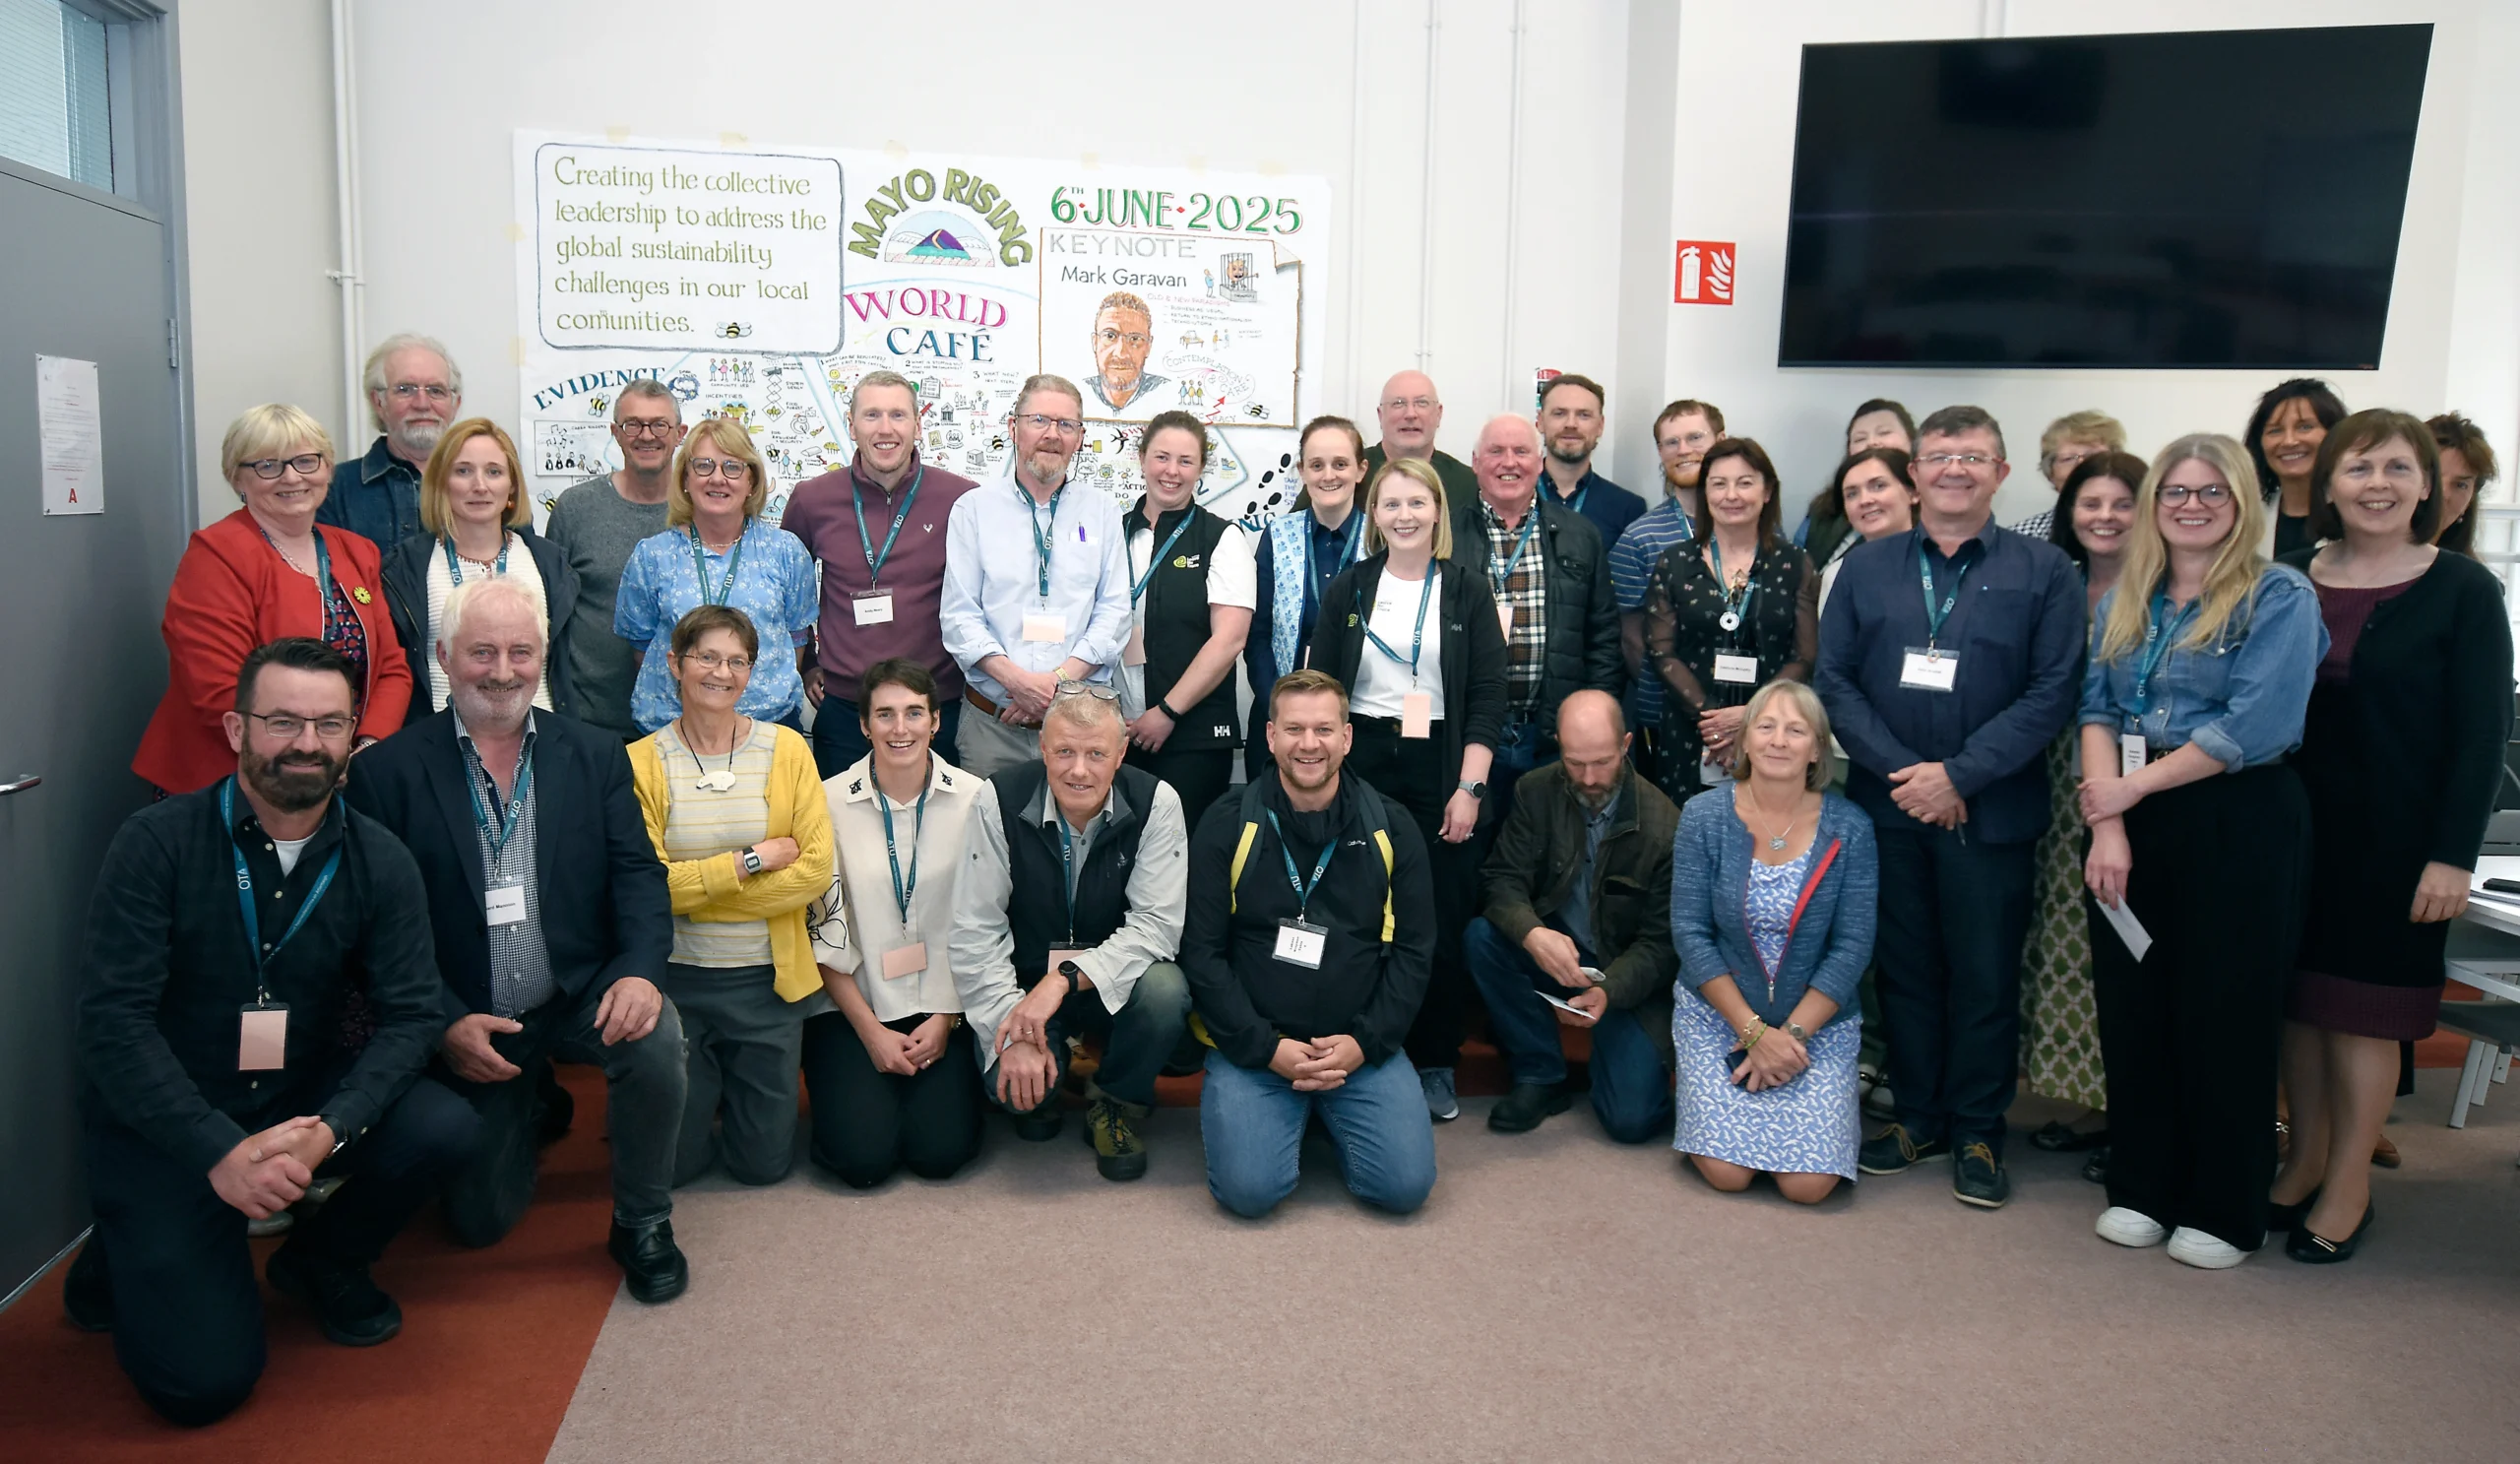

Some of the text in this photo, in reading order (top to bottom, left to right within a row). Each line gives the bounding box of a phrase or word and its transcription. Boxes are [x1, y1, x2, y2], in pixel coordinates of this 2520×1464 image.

[555, 156, 811, 195] Creating the collective
[555, 199, 827, 233] leadership to address the
[848, 167, 1034, 268] MAYO RISING
[1083, 187, 1174, 230] JUNE
[1187, 192, 1303, 235] 2025
[556, 234, 773, 270] global sustainability
[1049, 233, 1197, 259] KEYNOTE
[554, 270, 809, 303] challenges in our local
[1061, 265, 1187, 288] Mark Garavan
[844, 286, 1008, 328] WORLD
[886, 327, 994, 363] CAFÉ
[973, 370, 980, 379] 3
[68, 487, 78, 504] A
[1214, 725, 1230, 737] HH
[1063, 844, 1072, 861] ATU
